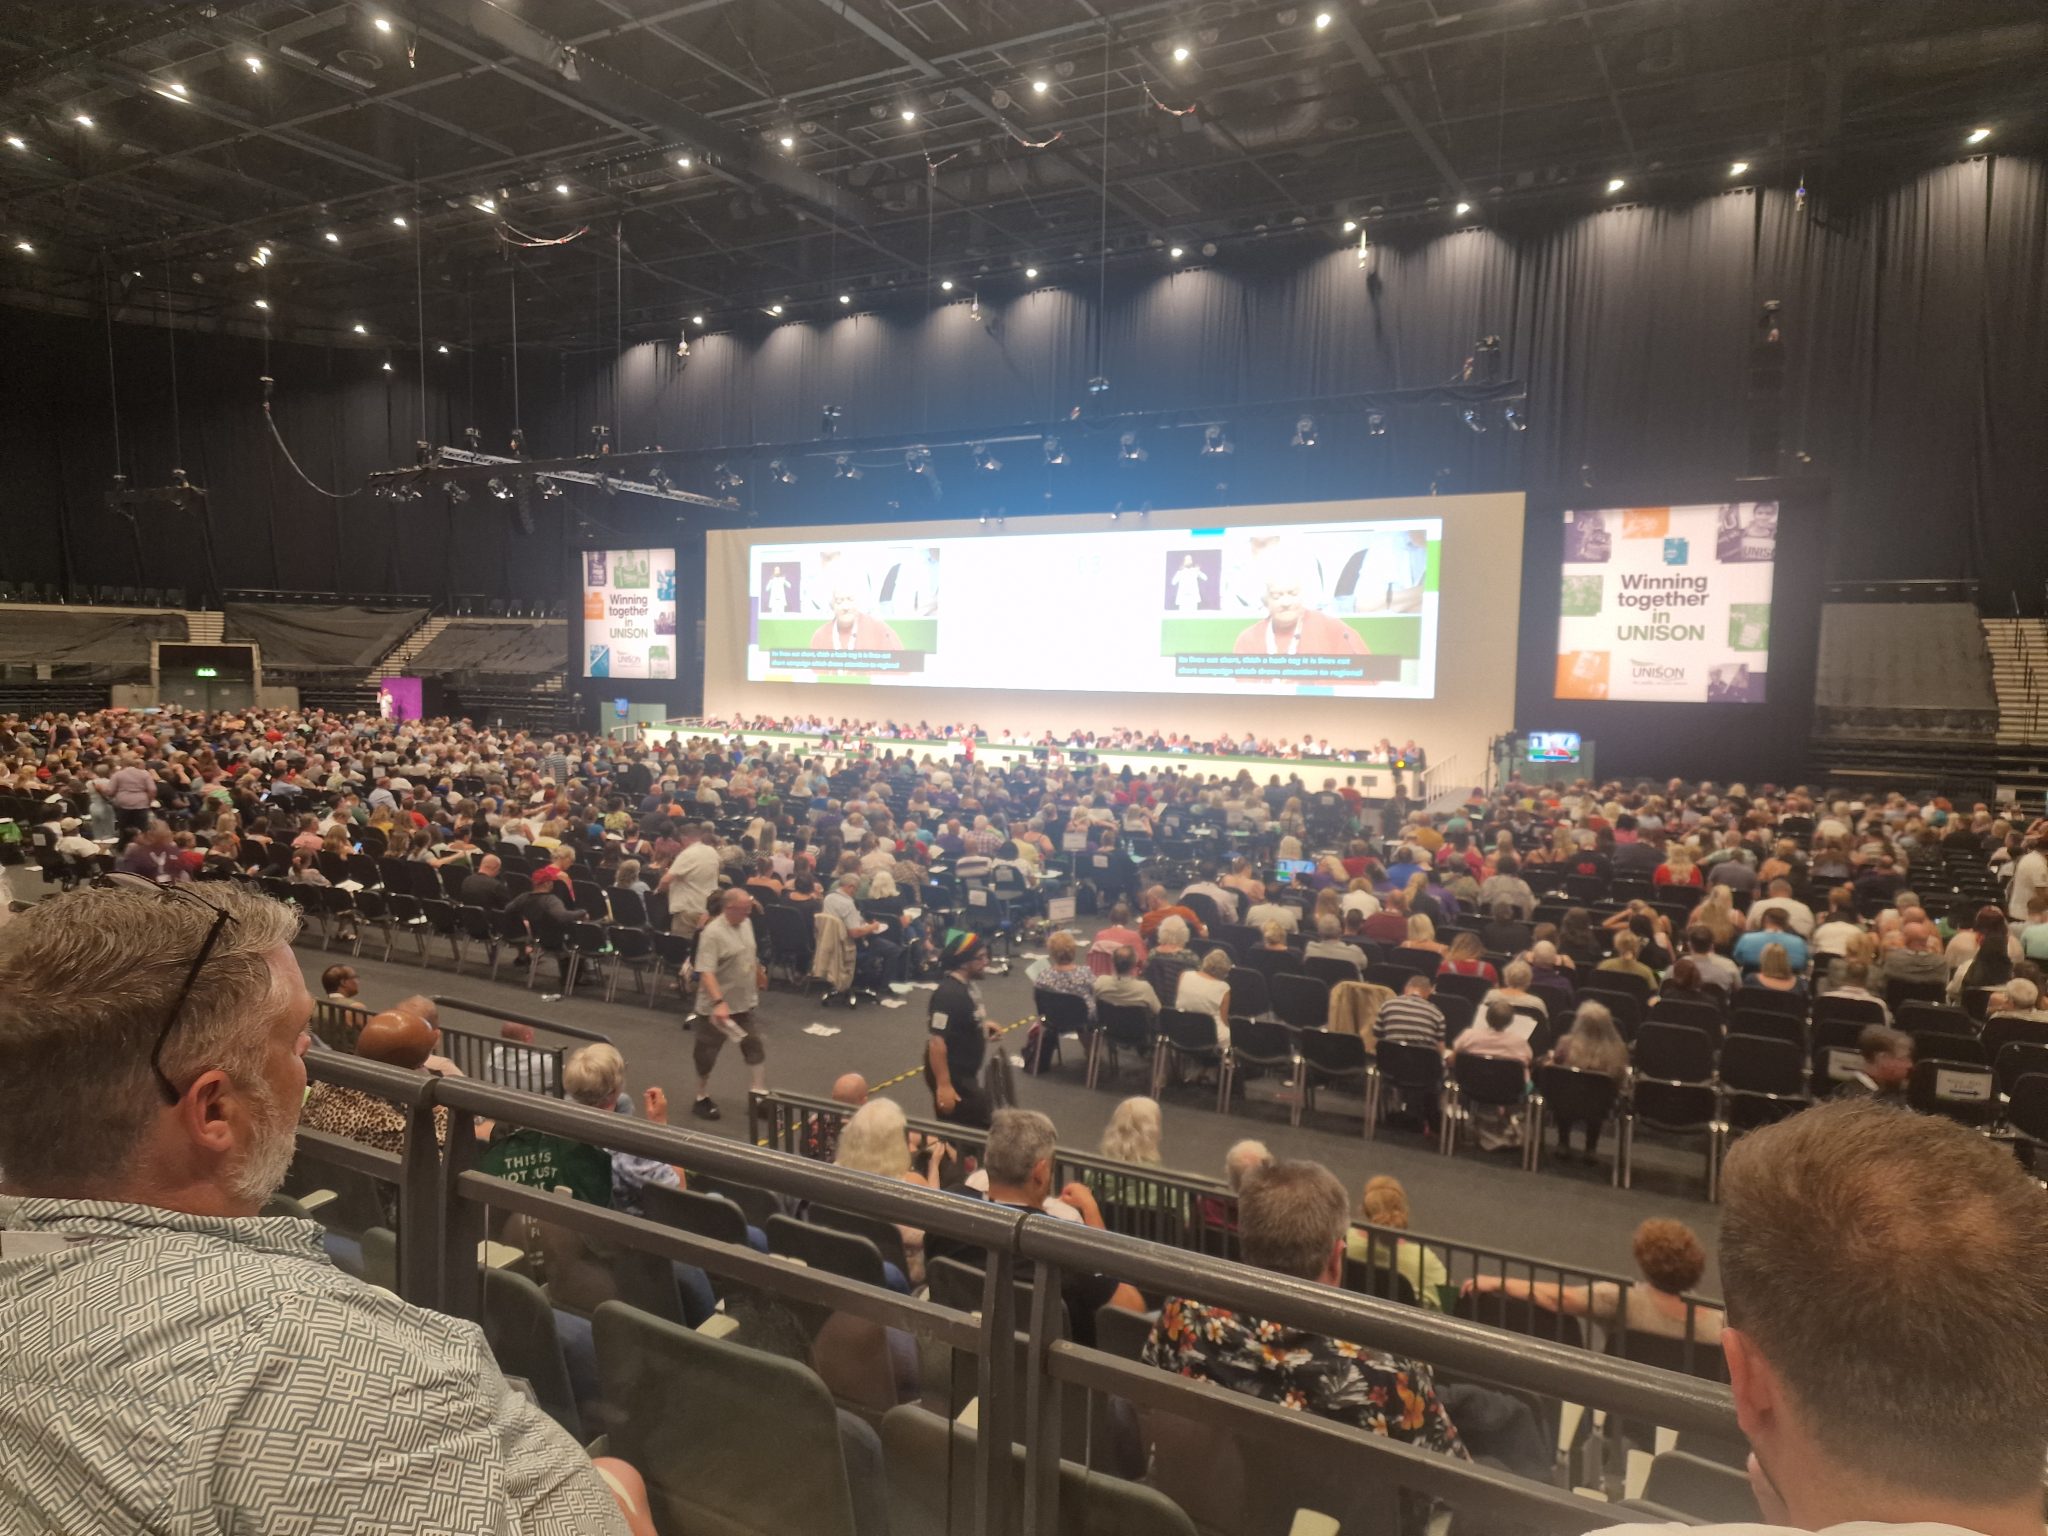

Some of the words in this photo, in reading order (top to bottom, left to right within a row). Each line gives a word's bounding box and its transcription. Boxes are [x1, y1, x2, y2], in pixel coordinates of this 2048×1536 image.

[1621, 573, 1708, 593] Winning
[610, 594, 648, 607] Winning
[1618, 591, 1710, 611] together
[609, 606, 649, 618] together
[1652, 608, 1670, 623] in
[624, 618, 633, 627] in
[609, 628, 648, 639] UNISON
[1617, 625, 1705, 641] UNISON
[1632, 666, 1685, 679] UNISON
[504, 1154, 536, 1169] THIS
[539, 1152, 552, 1163] IS
[532, 1166, 558, 1179] UST
